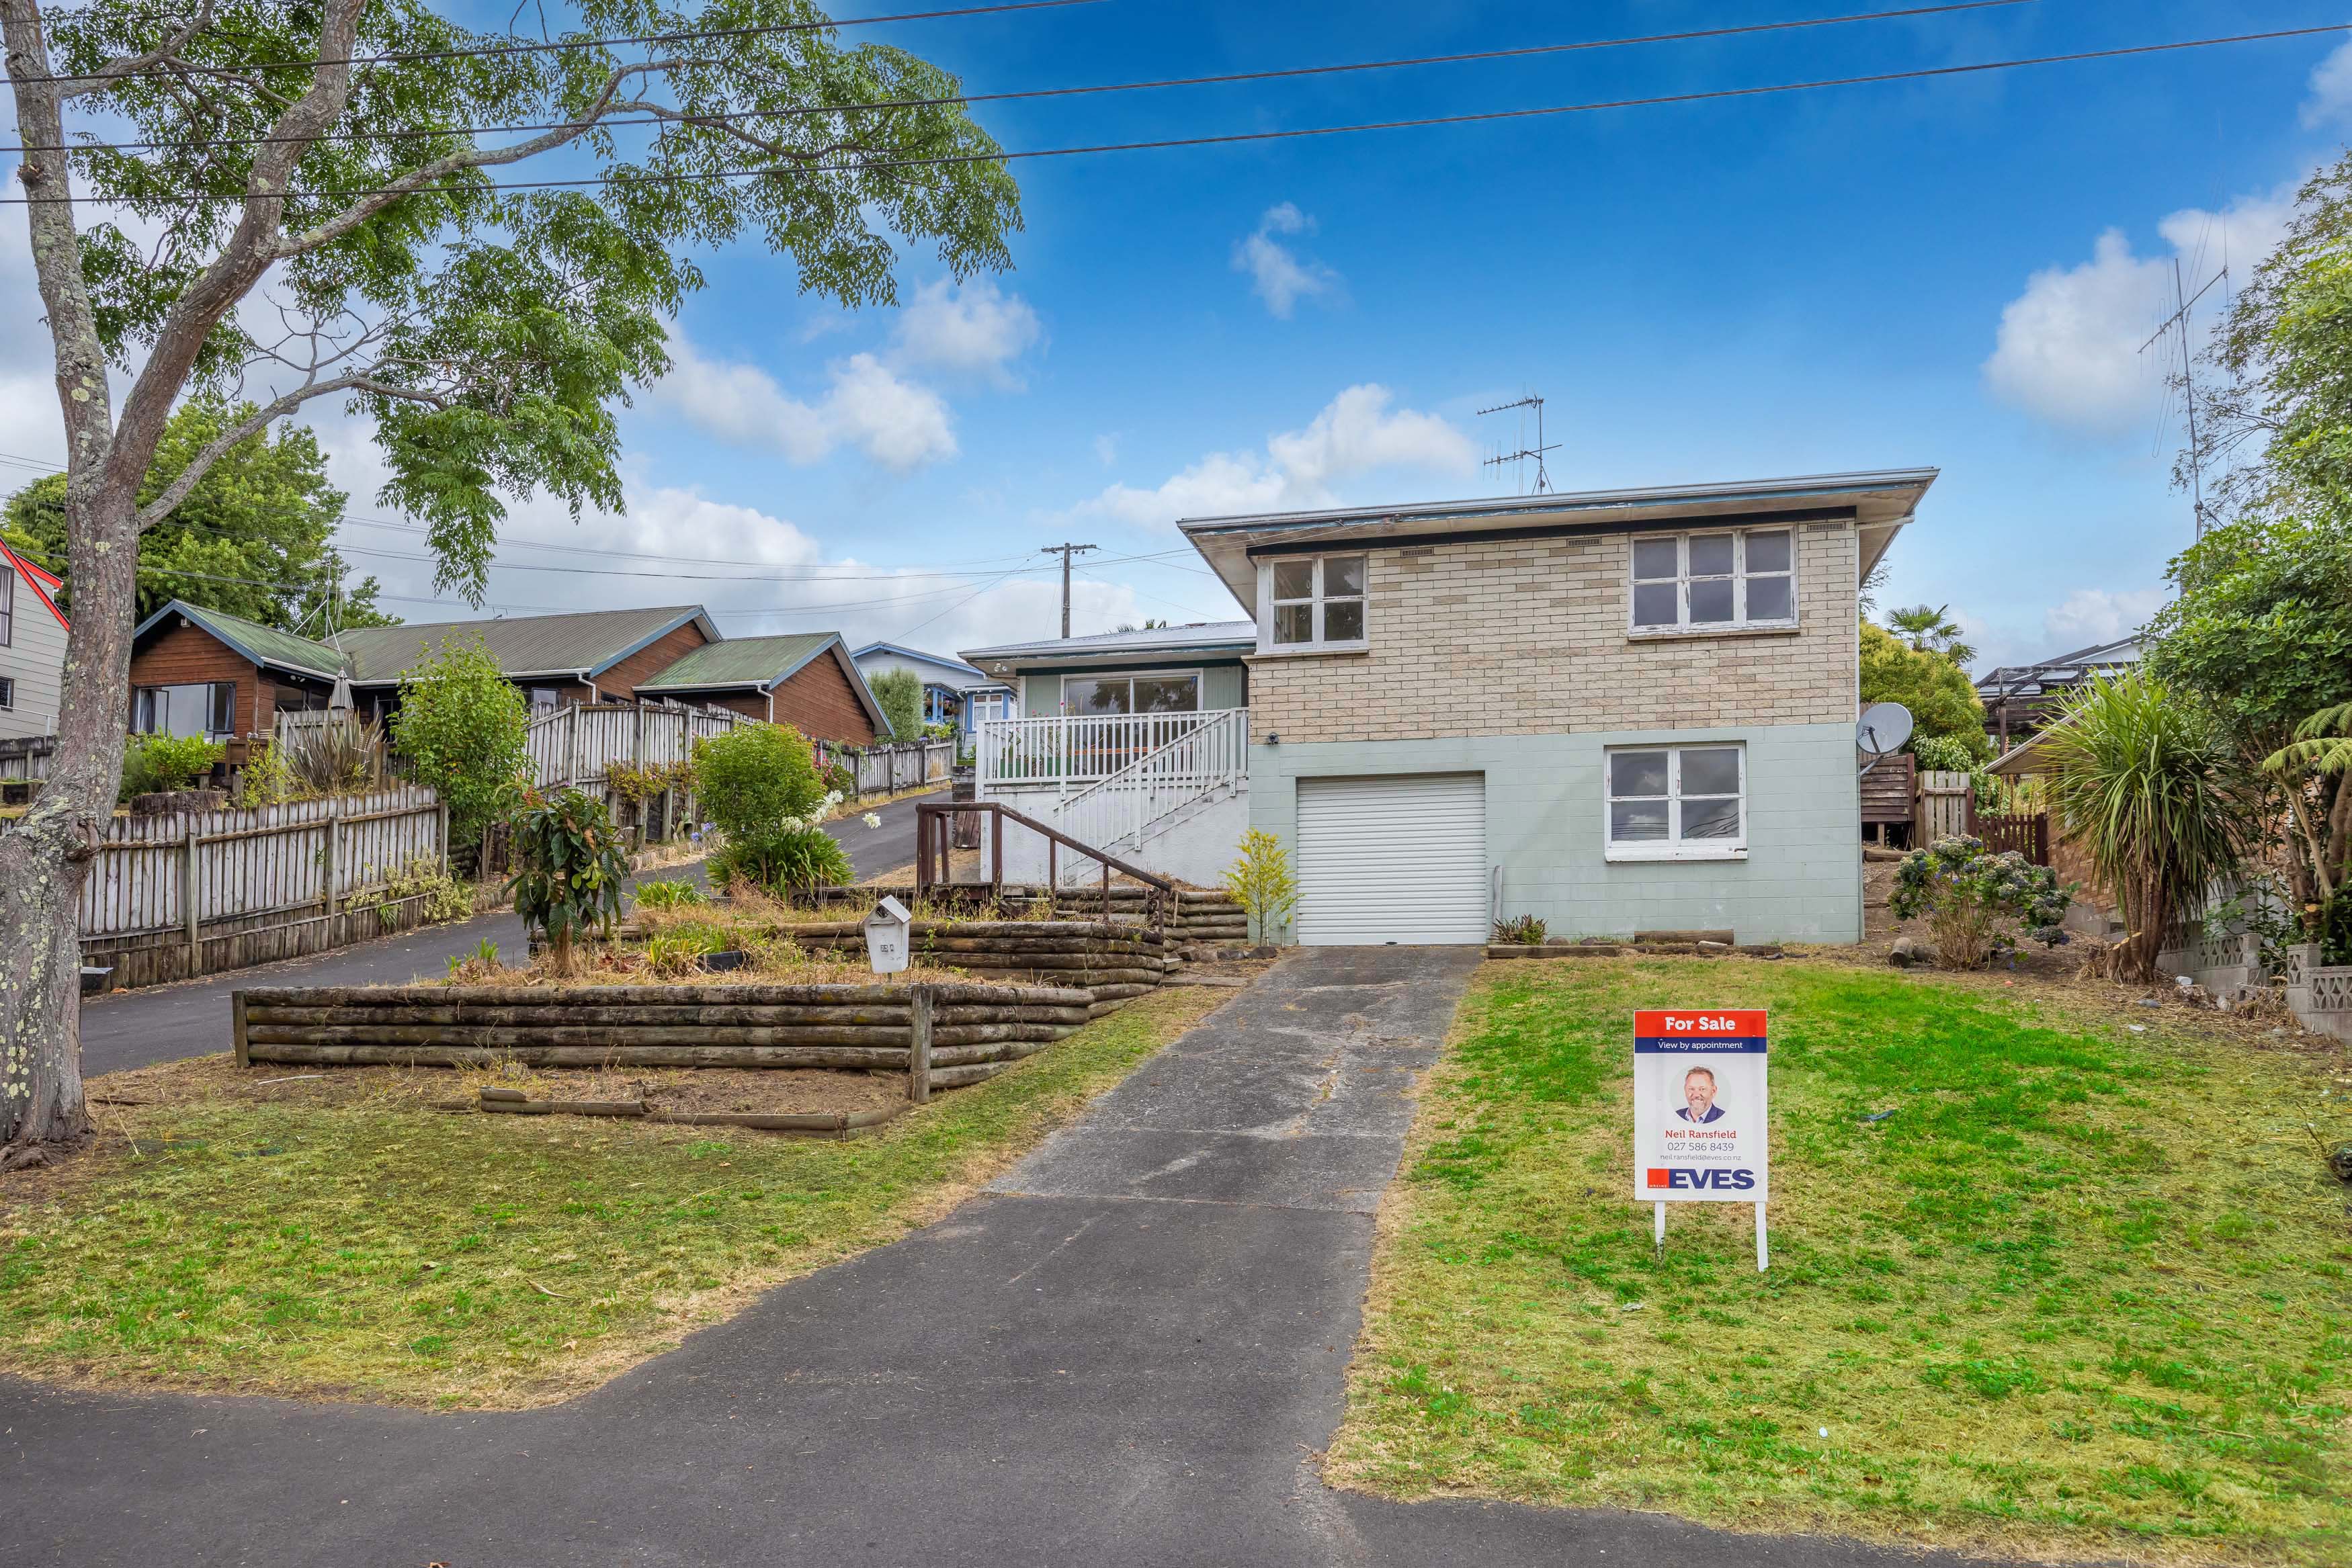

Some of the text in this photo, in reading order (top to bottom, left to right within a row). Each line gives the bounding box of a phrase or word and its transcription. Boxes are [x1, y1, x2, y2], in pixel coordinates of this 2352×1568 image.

[1665, 1016, 1736, 1031] For Sale
[1680, 1041, 1689, 1050] by
[1691, 1041, 1742, 1050] appointment
[1665, 1130, 1736, 1139] Neil Ransfield
[1667, 1143, 1734, 1151] 027 586 8439
[1669, 1169, 1755, 1190] EVES
